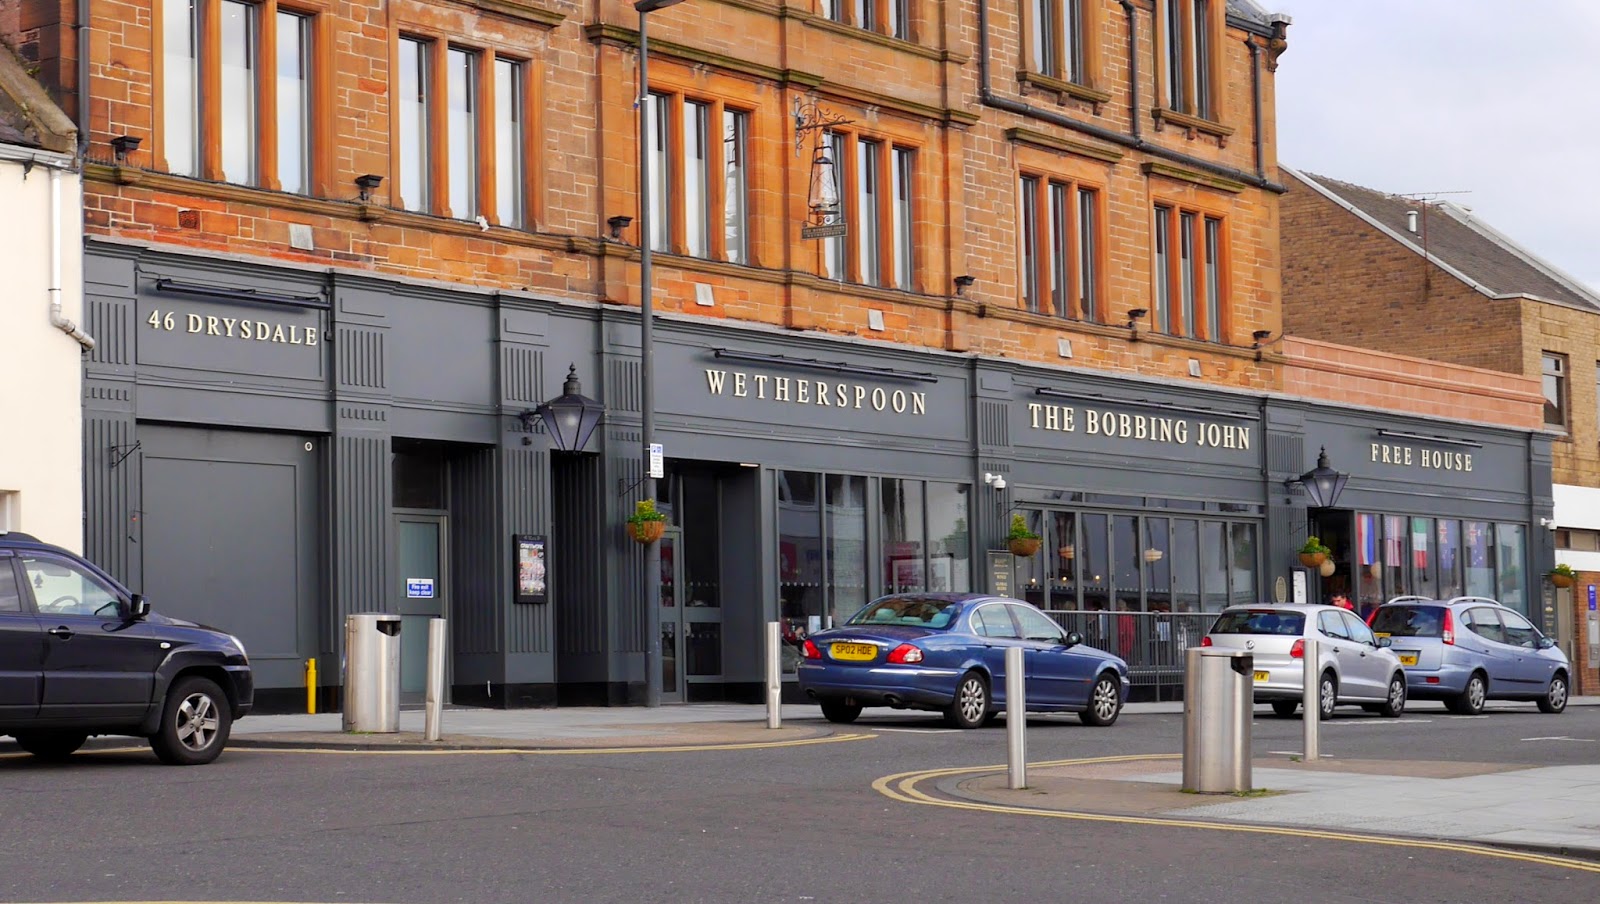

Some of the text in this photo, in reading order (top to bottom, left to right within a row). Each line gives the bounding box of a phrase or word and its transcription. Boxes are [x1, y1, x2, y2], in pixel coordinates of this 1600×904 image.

[147, 309, 318, 346] 46 DRYSDALE
[705, 369, 926, 415] WETHERSPOON
[1028, 403, 1250, 450] THE BOBBING JOHN
[1371, 443, 1473, 472] FREE HOUSE
[835, 645, 856, 655] SP02
